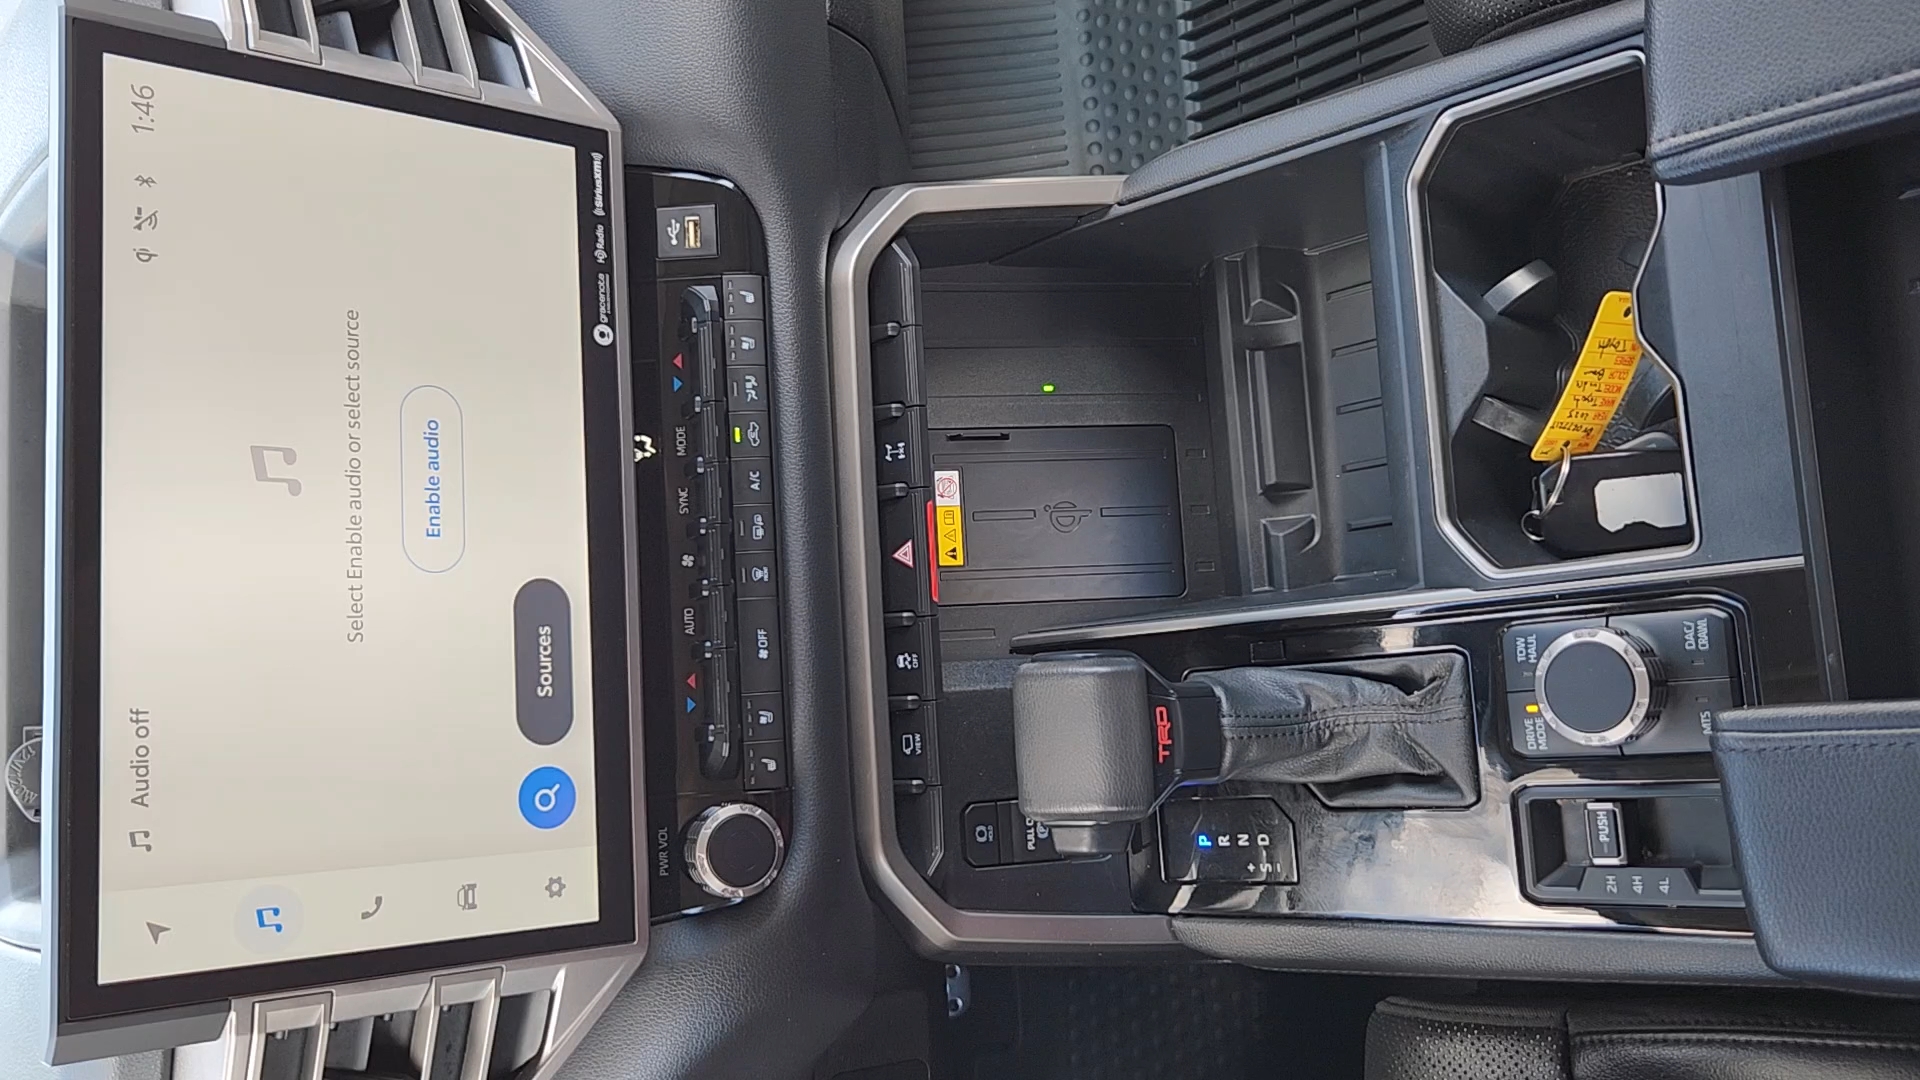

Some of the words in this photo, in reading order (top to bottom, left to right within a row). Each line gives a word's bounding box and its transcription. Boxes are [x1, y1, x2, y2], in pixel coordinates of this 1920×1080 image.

[131, 83, 155, 134] 1:46
[597, 272, 609, 324] gracenote
[346, 309, 360, 371] source
[344, 375, 361, 430] select
[348, 433, 361, 453] or
[423, 419, 440, 472] audio
[675, 425, 687, 456] MODE
[345, 457, 362, 510] audio
[749, 470, 761, 491] A/C
[425, 475, 442, 538] Enable
[678, 487, 690, 514] SYNC
[346, 514, 363, 579] Enable
[346, 585, 364, 643] Select
[683, 608, 696, 635] AUTO
[756, 628, 769, 648] OFF
[1683, 620, 1696, 650] DAC/
[1696, 617, 1710, 650] CRAWL
[536, 625, 553, 697] Sources
[911, 653, 919, 669] OFF
[1516, 637, 1527, 663] TOW
[1527, 634, 1538, 663] HAUL
[130, 707, 150, 739] off
[1155, 706, 1172, 764] TRD
[1524, 718, 1537, 750] DRIVE
[1534, 717, 1548, 750] MODE
[1700, 711, 1713, 735] MTS
[914, 733, 922, 755] VIEW
[130, 745, 150, 808] Audio
[657, 827, 669, 849] VOL
[1026, 827, 1036, 851] PULL
[1217, 834, 1231, 847] R
[1236, 833, 1250, 846] N
[1256, 834, 1270, 846] D
[1596, 811, 1609, 842] PUSH
[1198, 835, 1212, 847] P
[659, 851, 670, 876] PWR
[1259, 863, 1272, 873] S
[1606, 875, 1619, 894] 2H
[1632, 875, 1644, 894] 4H
[1658, 877, 1670, 894] 4L
